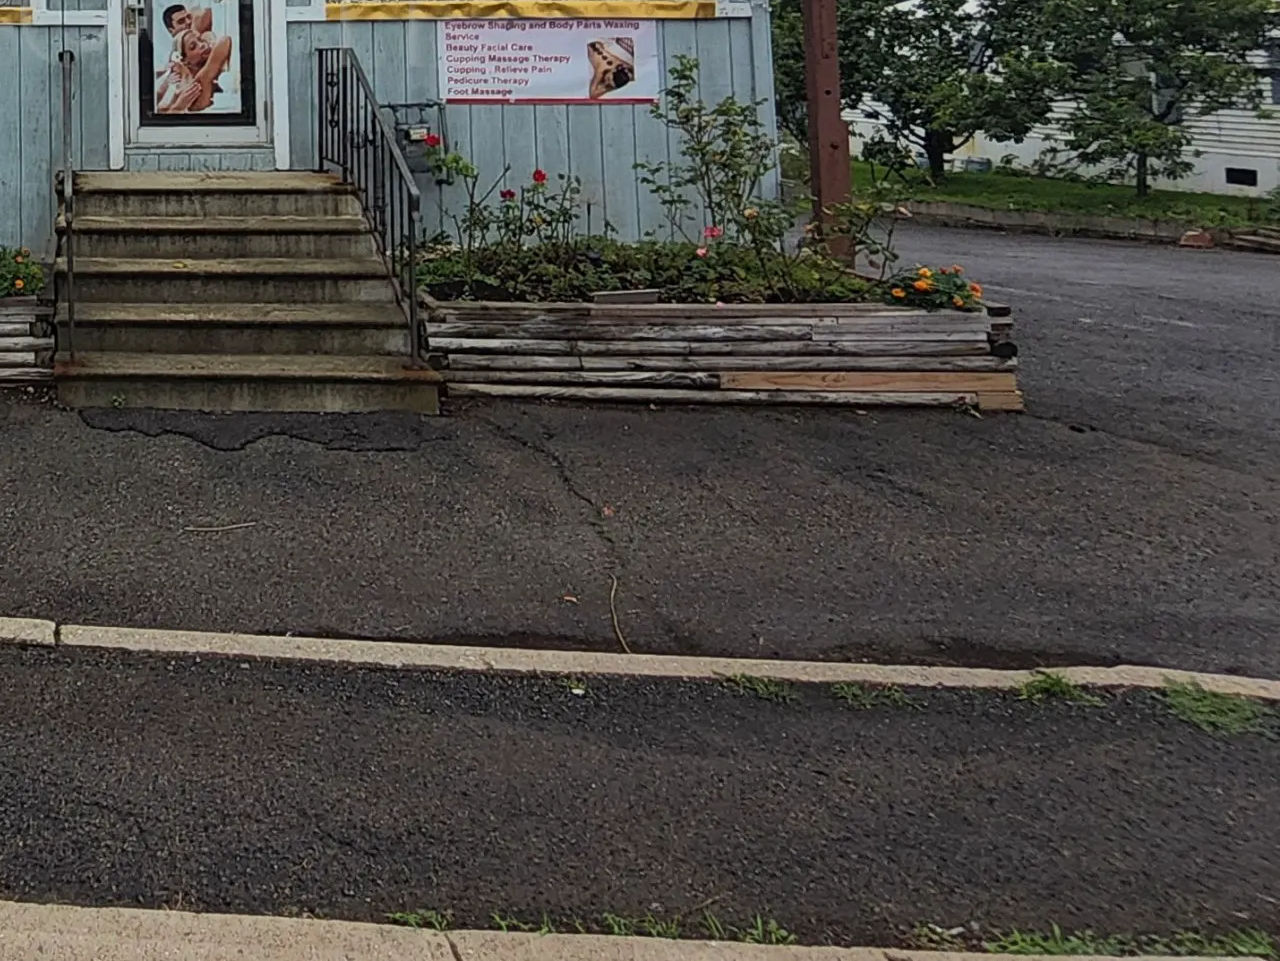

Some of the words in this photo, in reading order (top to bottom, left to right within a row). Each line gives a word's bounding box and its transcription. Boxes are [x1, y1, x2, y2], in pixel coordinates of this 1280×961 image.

[444, 21, 485, 31] Eyebrow
[487, 21, 527, 31] Shaping
[528, 21, 547, 30] and
[548, 21, 574, 31] Body
[576, 20, 602, 30] Parts
[603, 20, 640, 31] Waxing
[445, 33, 480, 41] Service
[446, 44, 478, 53] Beauty
[481, 44, 508, 52] Facial
[510, 43, 533, 52] Care
[446, 55, 486, 64] Cupping
[488, 55, 530, 64] Massage
[532, 54, 571, 64] Therapy
[447, 66, 487, 75] Cupping
[494, 66, 529, 74] Relieve
[531, 66, 553, 74] Pain
[447, 77, 489, 85] Pedicure
[491, 77, 530, 86] Therapy
[447, 88, 469, 96] Foot
[471, 88, 514, 97] Massage
